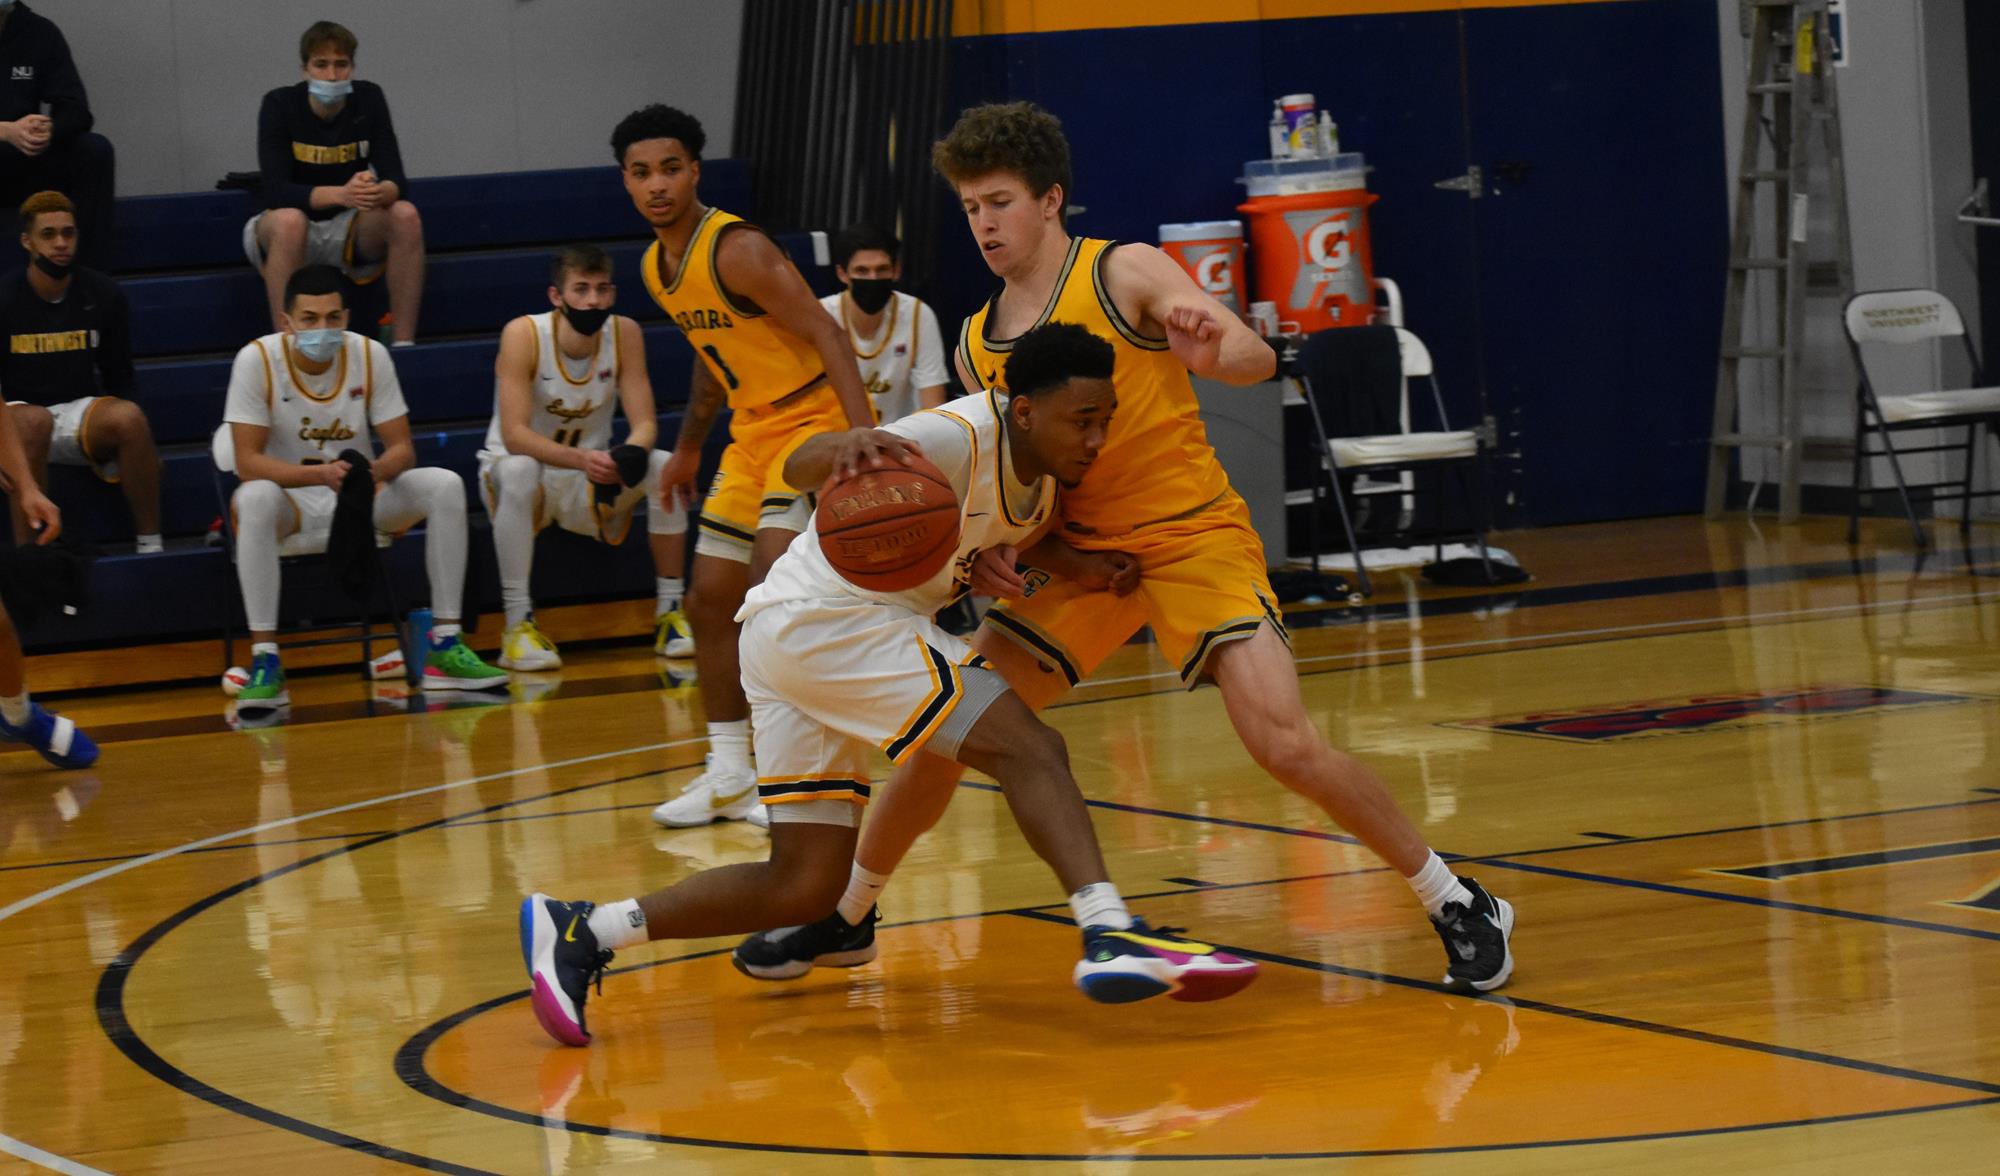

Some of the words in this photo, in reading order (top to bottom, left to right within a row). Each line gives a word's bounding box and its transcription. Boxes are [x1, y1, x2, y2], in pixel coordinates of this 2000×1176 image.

[12, 66, 34, 77] NU
[1308, 220, 1350, 269] G
[1197, 251, 1232, 292] G
[298, 416, 357, 450] Eagles
